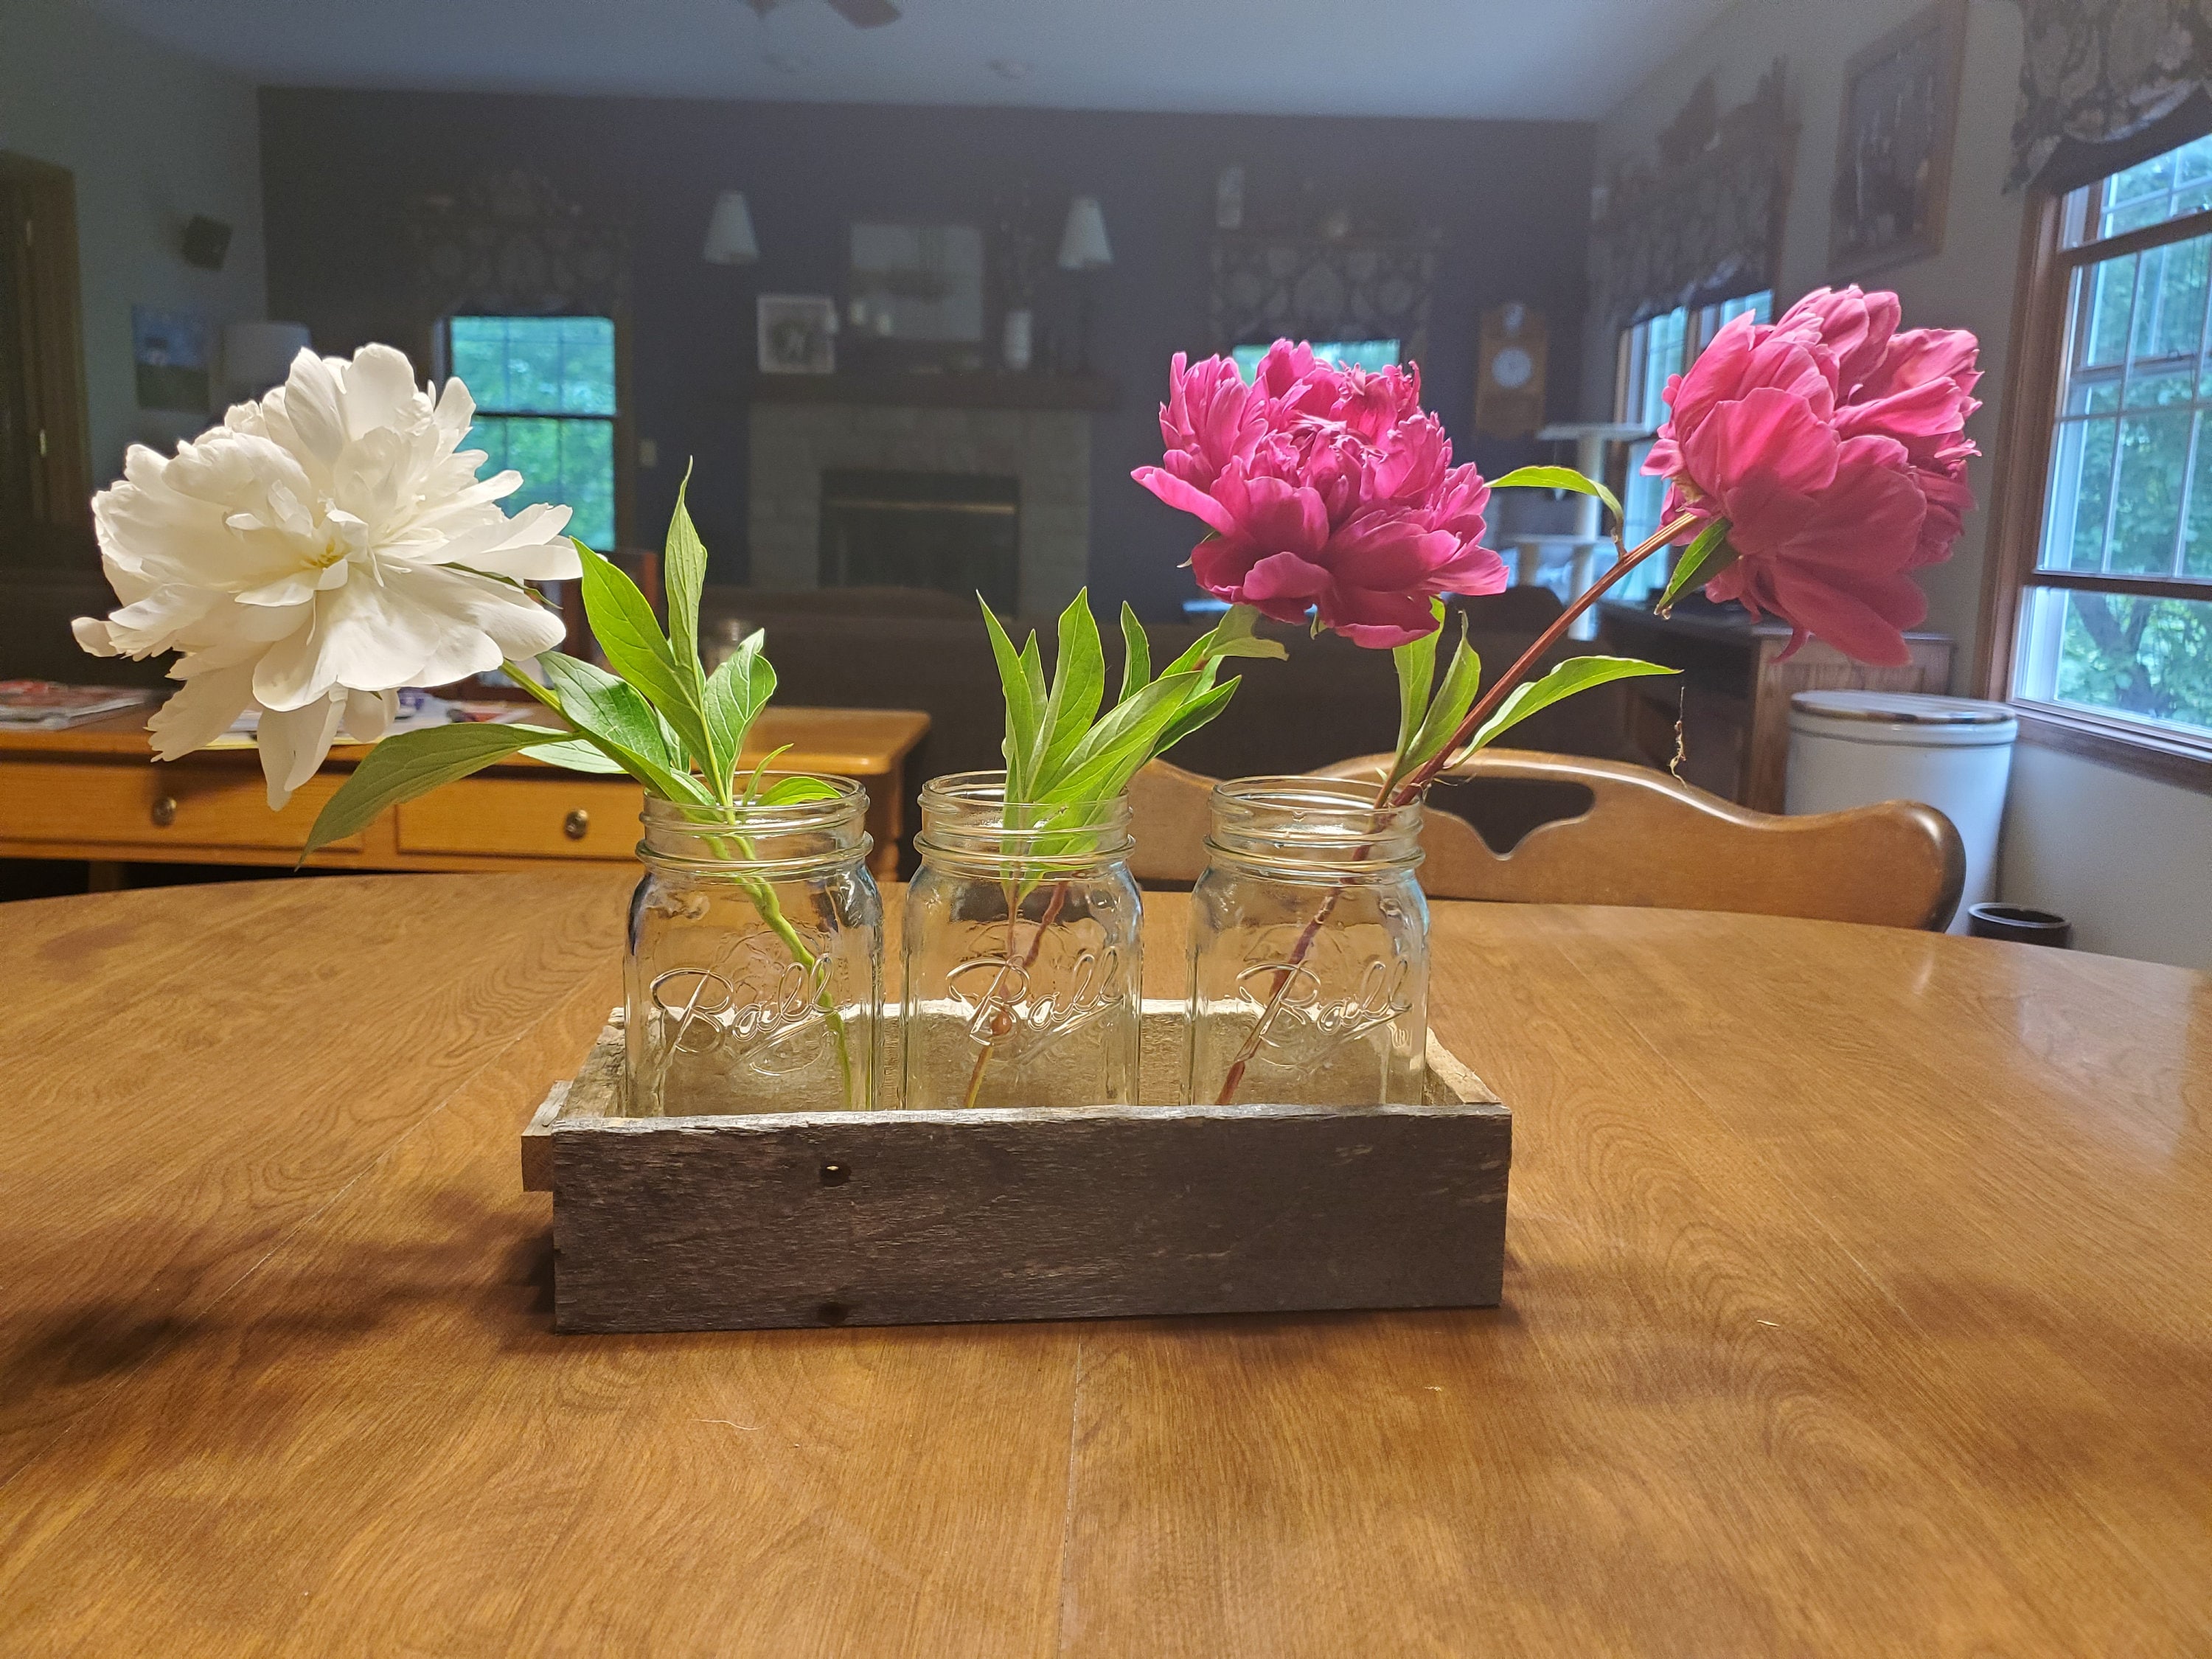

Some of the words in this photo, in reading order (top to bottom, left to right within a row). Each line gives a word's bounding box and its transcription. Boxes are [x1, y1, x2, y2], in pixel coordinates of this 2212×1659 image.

[650, 953, 838, 1053] Ball
[946, 946, 1124, 1047] Ball
[1236, 959, 1413, 1048] Ball
